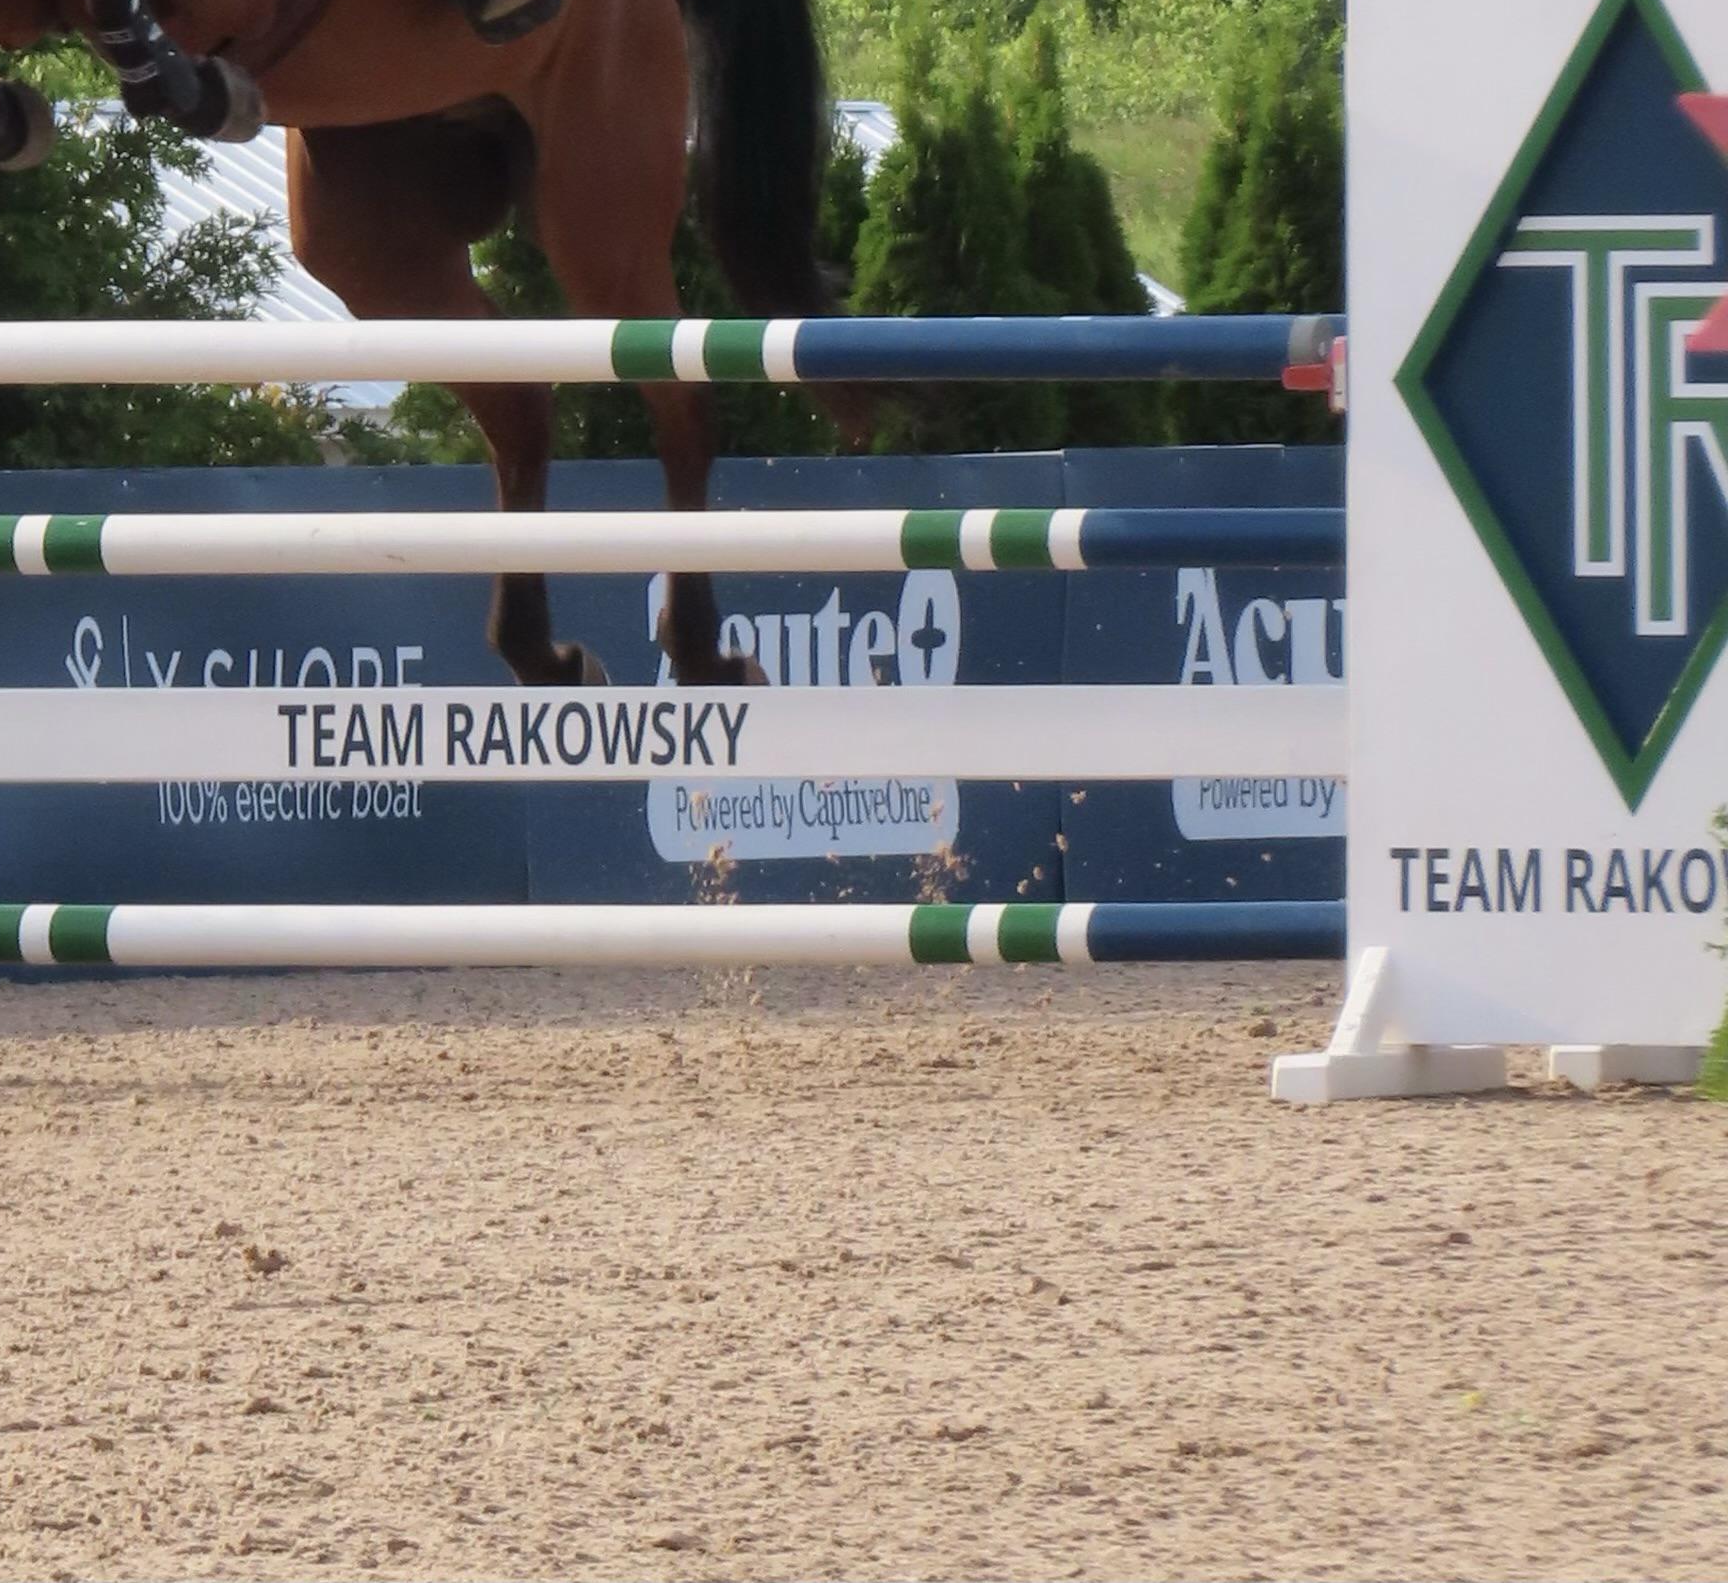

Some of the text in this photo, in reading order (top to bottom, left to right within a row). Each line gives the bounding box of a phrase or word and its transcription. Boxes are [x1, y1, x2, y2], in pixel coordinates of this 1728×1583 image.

[278, 701, 750, 768] TEAM RAKOWSKY
[157, 780, 228, 824] 100%
[770, 782, 795, 840] by
[799, 778, 932, 840] CaptiveOne
[1389, 847, 1728, 914] TEAM RAKO
